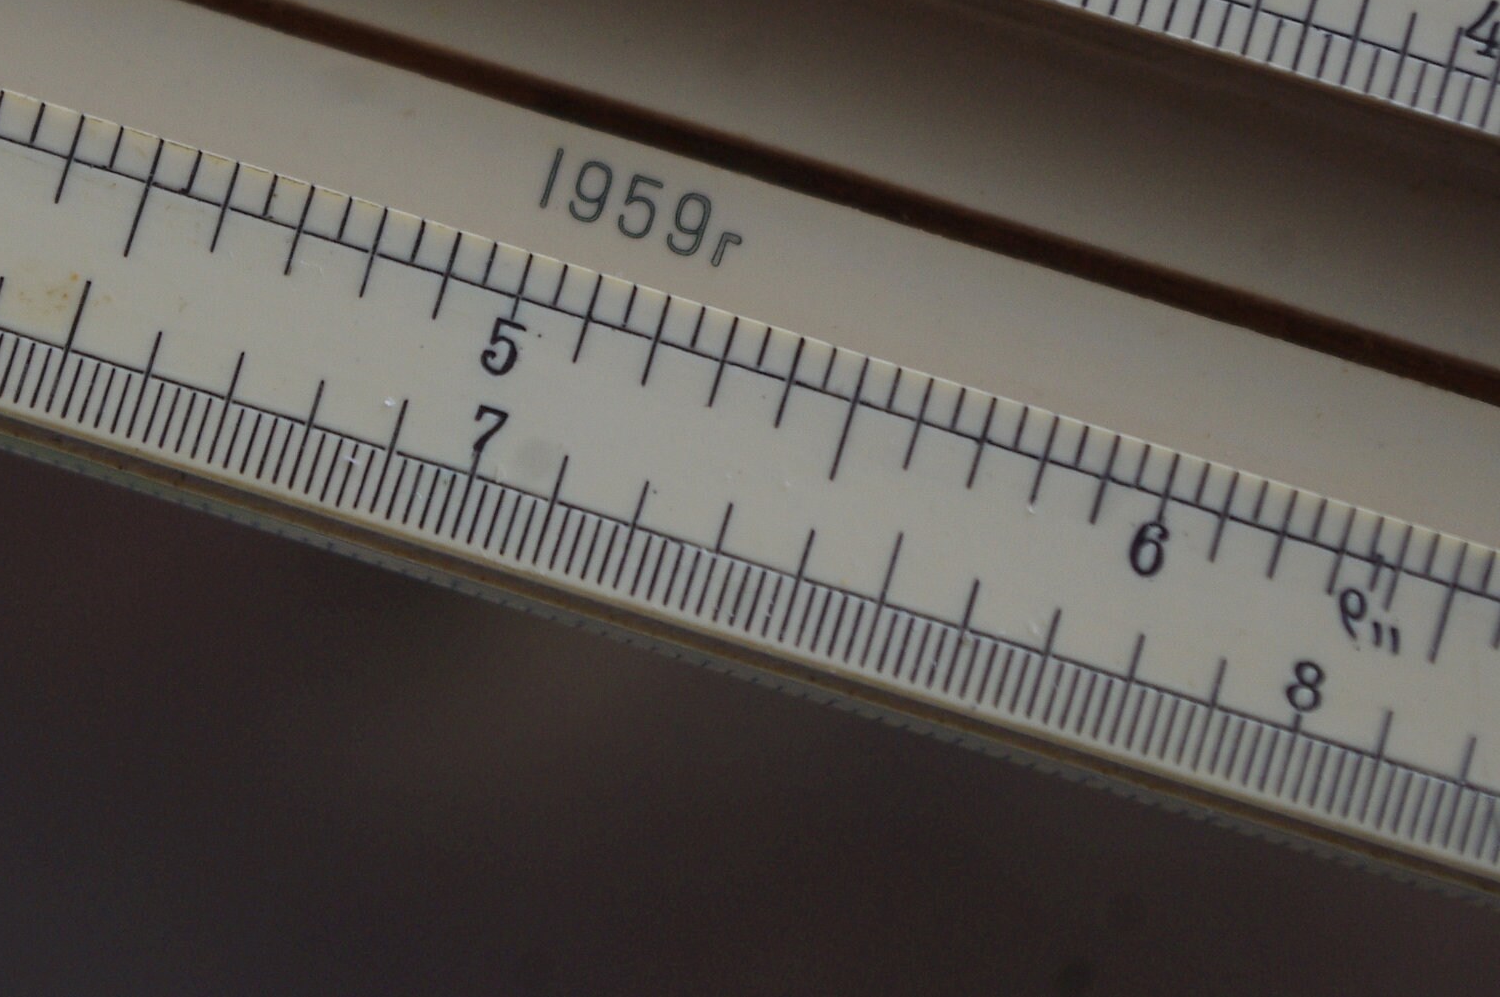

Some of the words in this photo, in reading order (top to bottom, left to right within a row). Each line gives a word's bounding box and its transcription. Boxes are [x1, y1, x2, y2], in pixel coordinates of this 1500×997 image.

[473, 404, 510, 454] 7
[1285, 660, 1325, 712] 8
[480, 316, 527, 376] 5
[1129, 520, 1170, 577] 6
